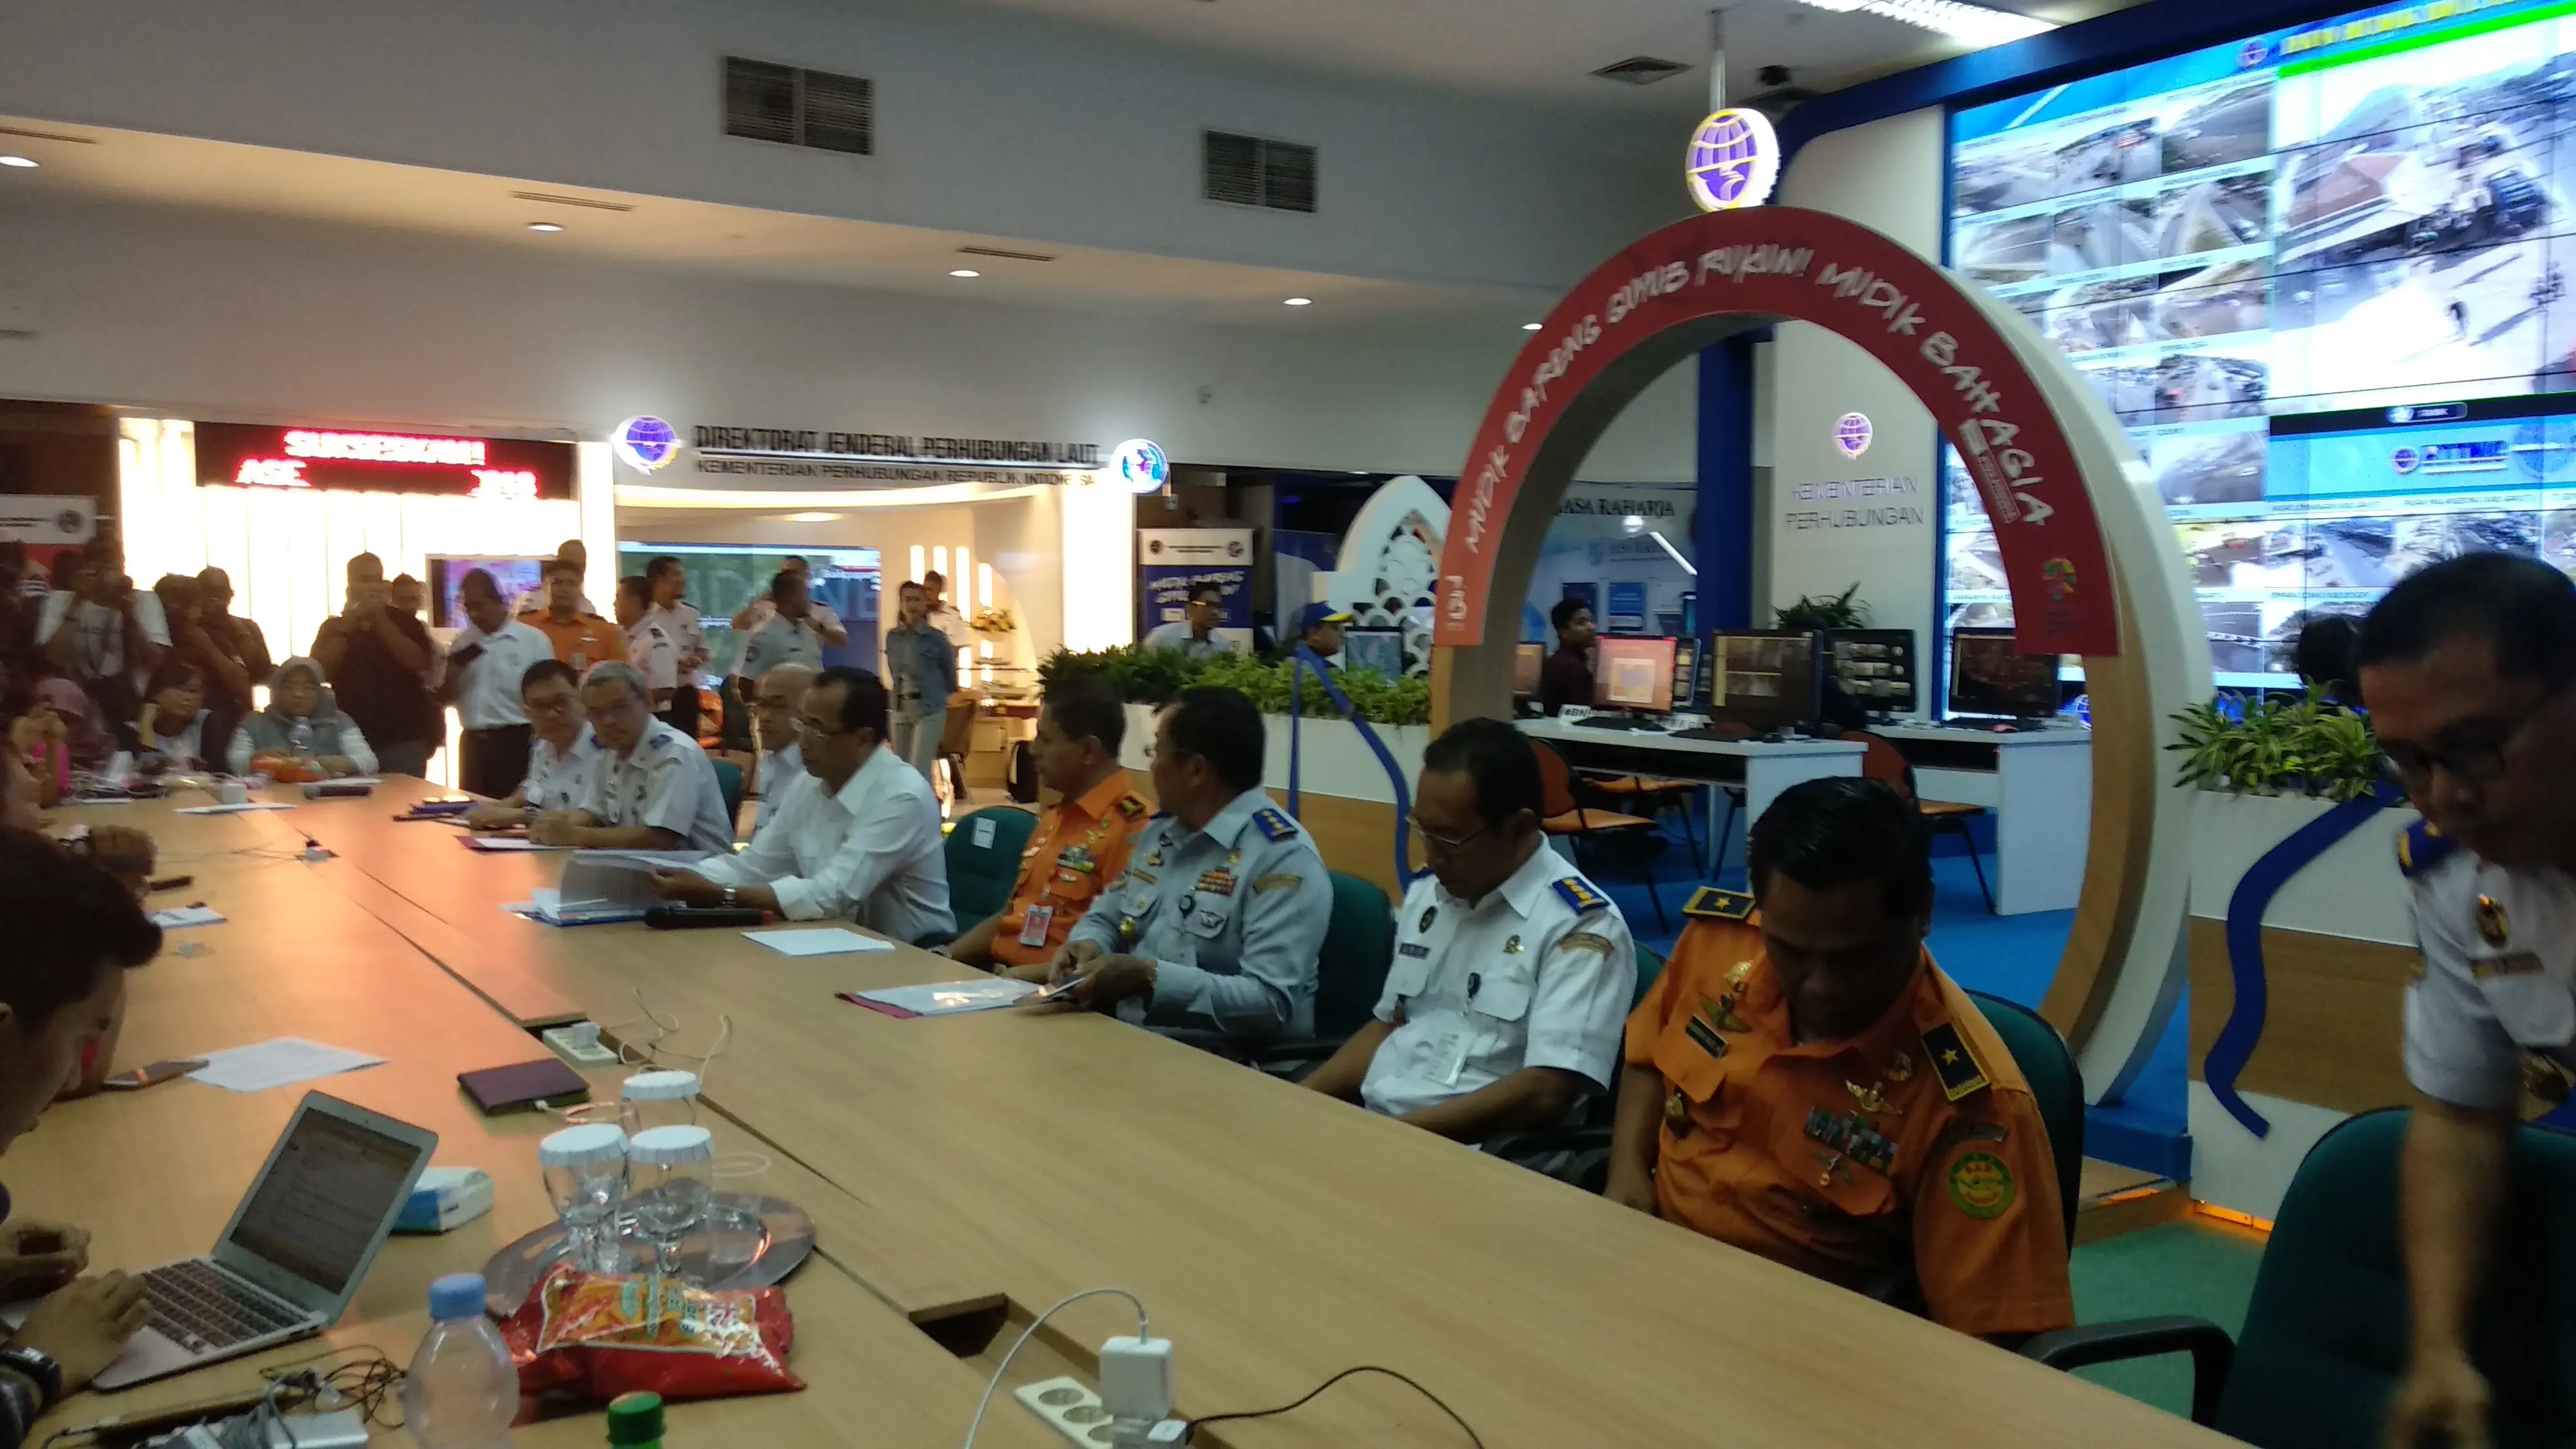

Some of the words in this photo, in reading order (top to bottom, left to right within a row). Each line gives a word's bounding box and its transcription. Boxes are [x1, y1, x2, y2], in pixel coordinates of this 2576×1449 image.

[1464, 445, 1510, 554] MUDIK
[1504, 314, 1602, 444] BARENG
[1815, 263, 1926, 336] MUDIK
[1920, 330, 2054, 526] BAHAGIA
[696, 459, 817, 477] KEMENTERIAN
[820, 464, 943, 482] PERHUBUNGAN
[946, 470, 1021, 484] REPUBLIK
[1790, 477, 1919, 501] KEMENTERIAN
[1598, 498, 1675, 519] RAHARJA
[1785, 507, 1924, 530] PERHUBUNGAN
